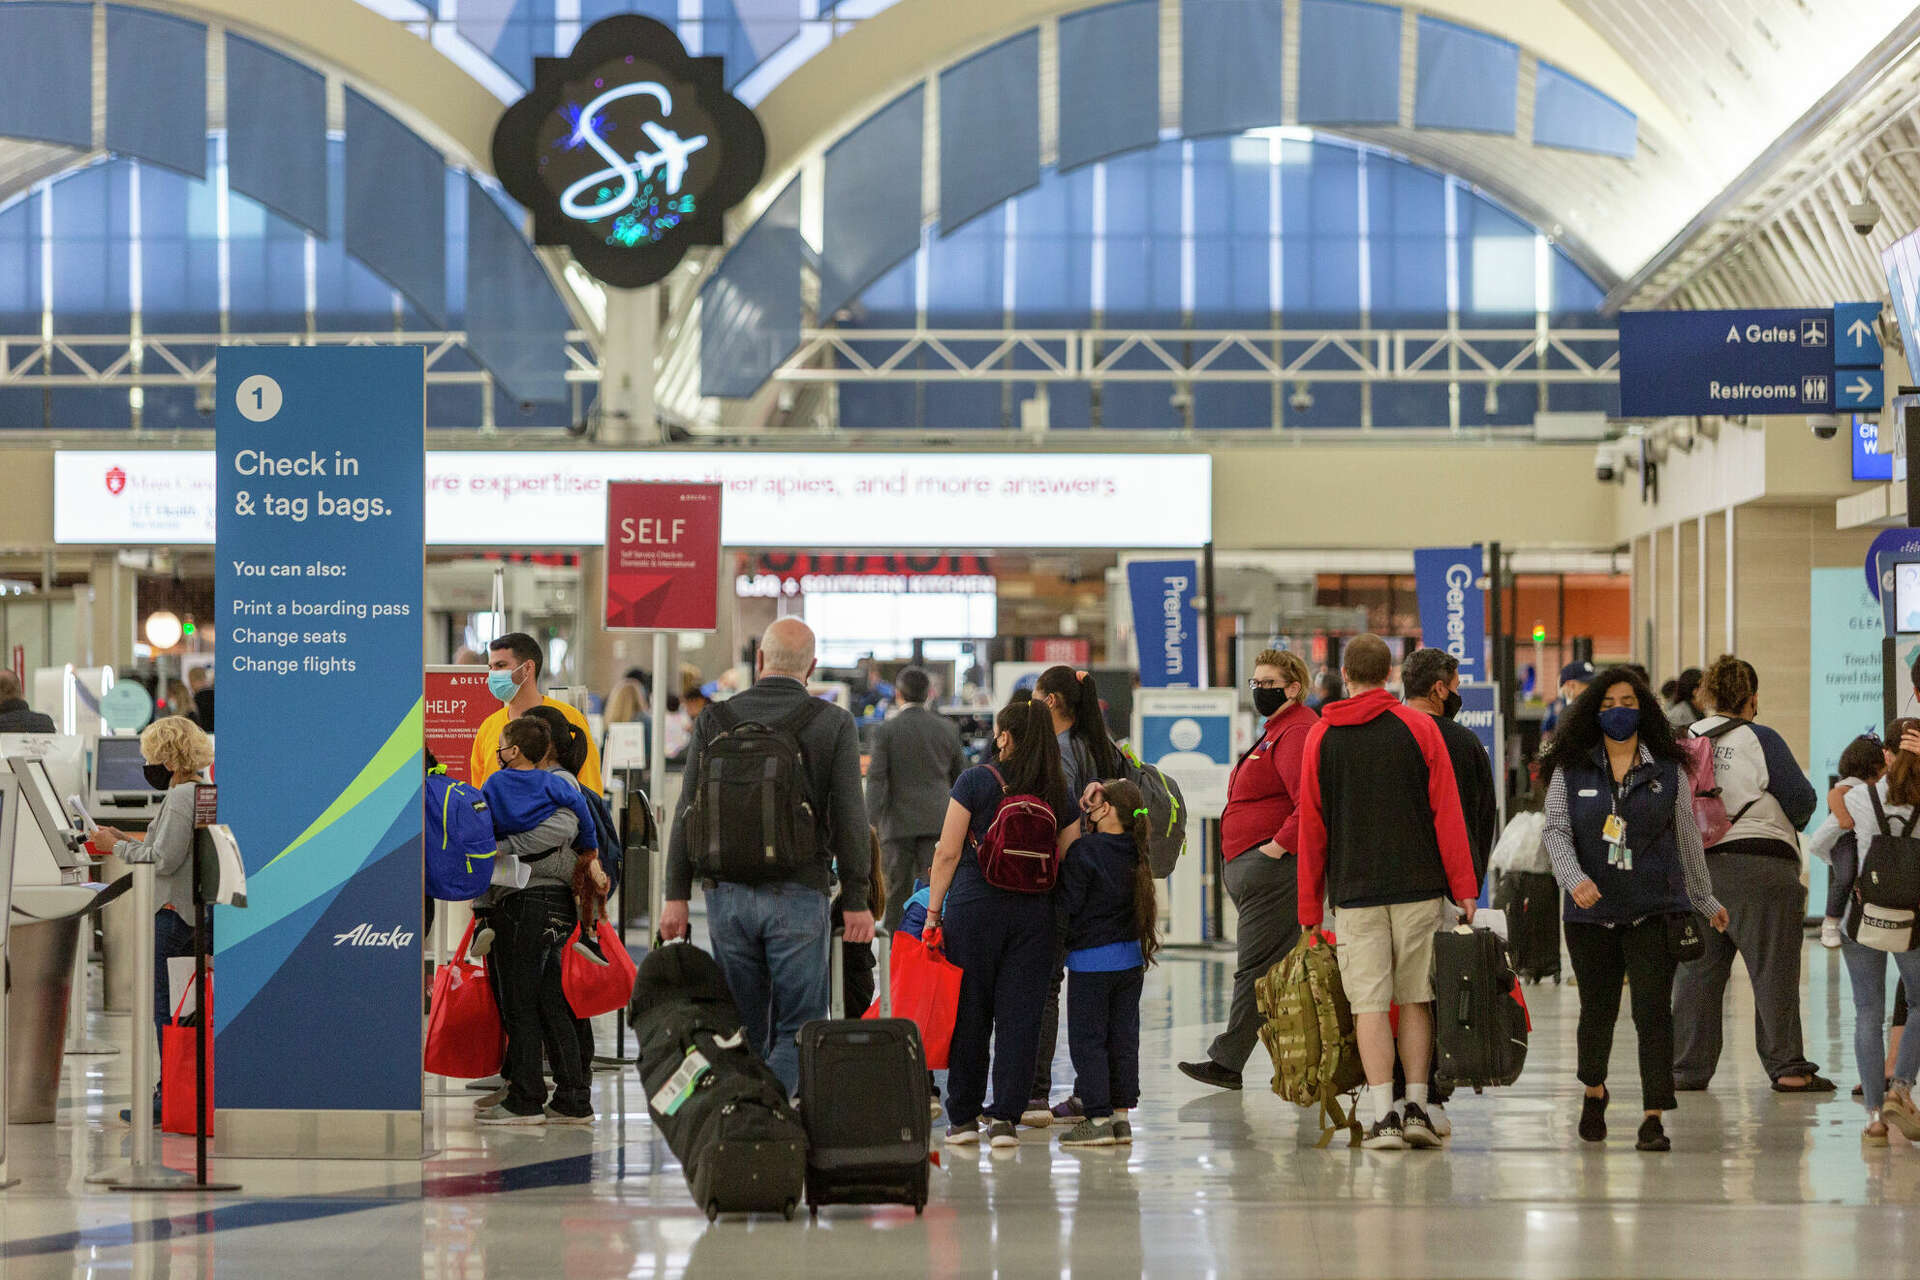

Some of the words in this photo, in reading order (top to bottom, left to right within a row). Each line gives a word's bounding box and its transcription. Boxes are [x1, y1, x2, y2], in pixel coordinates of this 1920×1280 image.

[1726, 324, 1741, 343] A
[1746, 324, 1796, 343] Gates
[252, 386, 263, 410] 1
[1710, 380, 1796, 399] Restrooms
[234, 449, 327, 476] Check
[335, 450, 359, 476] in
[235, 490, 257, 516] &
[264, 493, 308, 522] tag
[317, 490, 392, 522] bags.
[620, 518, 686, 544] SELF
[232, 561, 266, 577] You
[270, 563, 301, 577] can
[306, 561, 347, 577] also:
[232, 600, 272, 616] Print
[277, 603, 287, 616] a
[292, 600, 367, 619] boarding
[372, 603, 410, 619] pass
[1445, 564, 1475, 665] General
[1164, 576, 1188, 675] Premium
[1849, 617, 1882, 630] CLEA
[232, 628, 299, 647] Change
[303, 629, 347, 644] seats
[232, 656, 299, 675] Change
[304, 656, 356, 675] flights
[425, 700, 467, 714] HELP?
[1863, 916, 1898, 929] adden
[333, 923, 414, 950] Alaska
